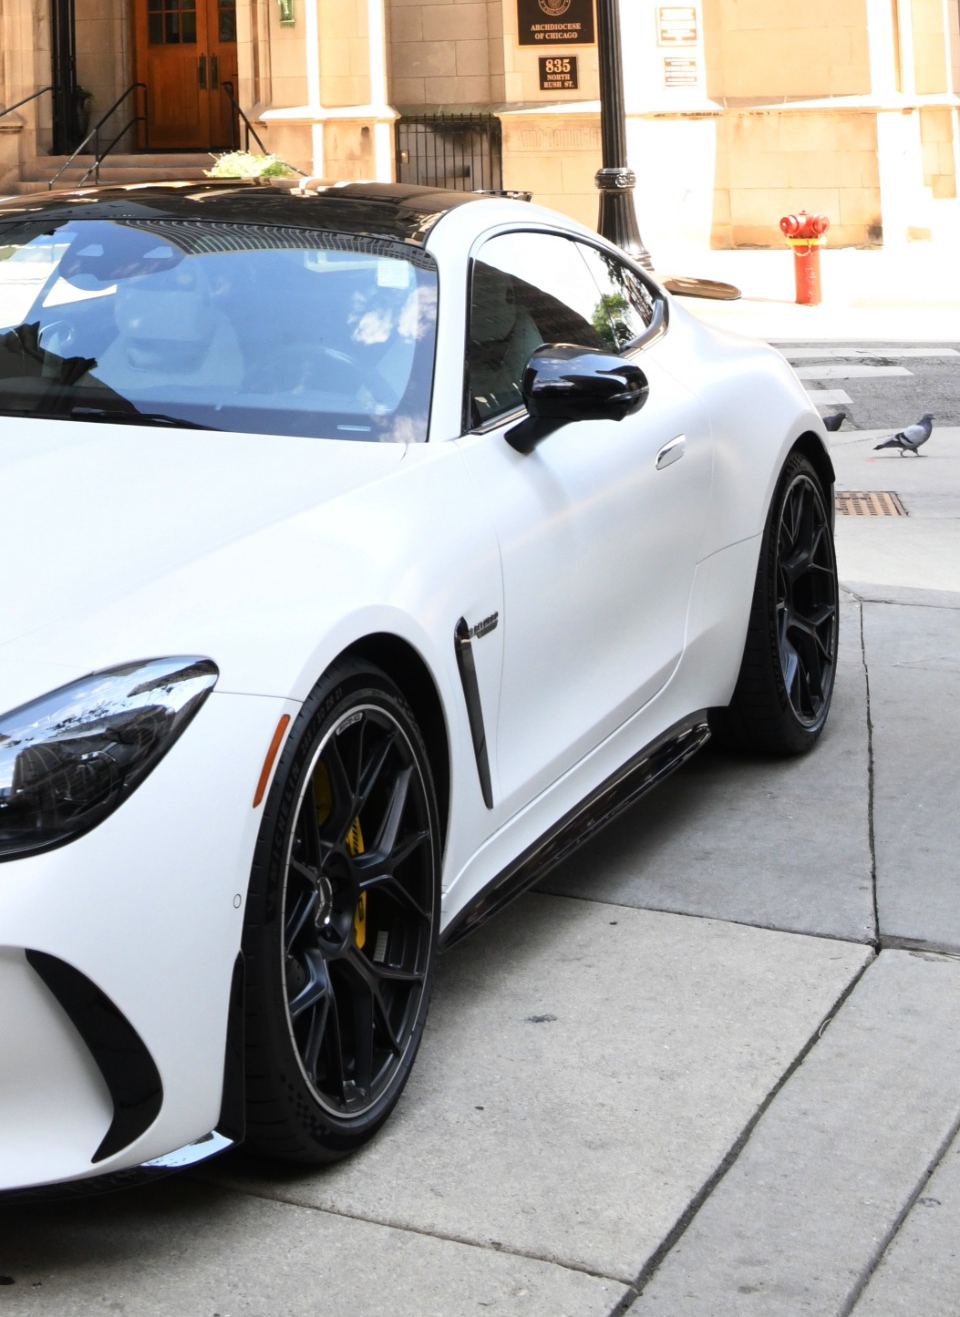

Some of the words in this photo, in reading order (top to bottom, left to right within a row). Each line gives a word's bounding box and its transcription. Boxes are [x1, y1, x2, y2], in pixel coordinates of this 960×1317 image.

[531, 22, 581, 31] ARCHDIOCESE
[534, 32, 545, 40] OF
[545, 31, 578, 39] CHICAGO
[545, 58, 571, 73] 835
[546, 73, 570, 81] NORTH
[564, 80, 575, 88] ST.
